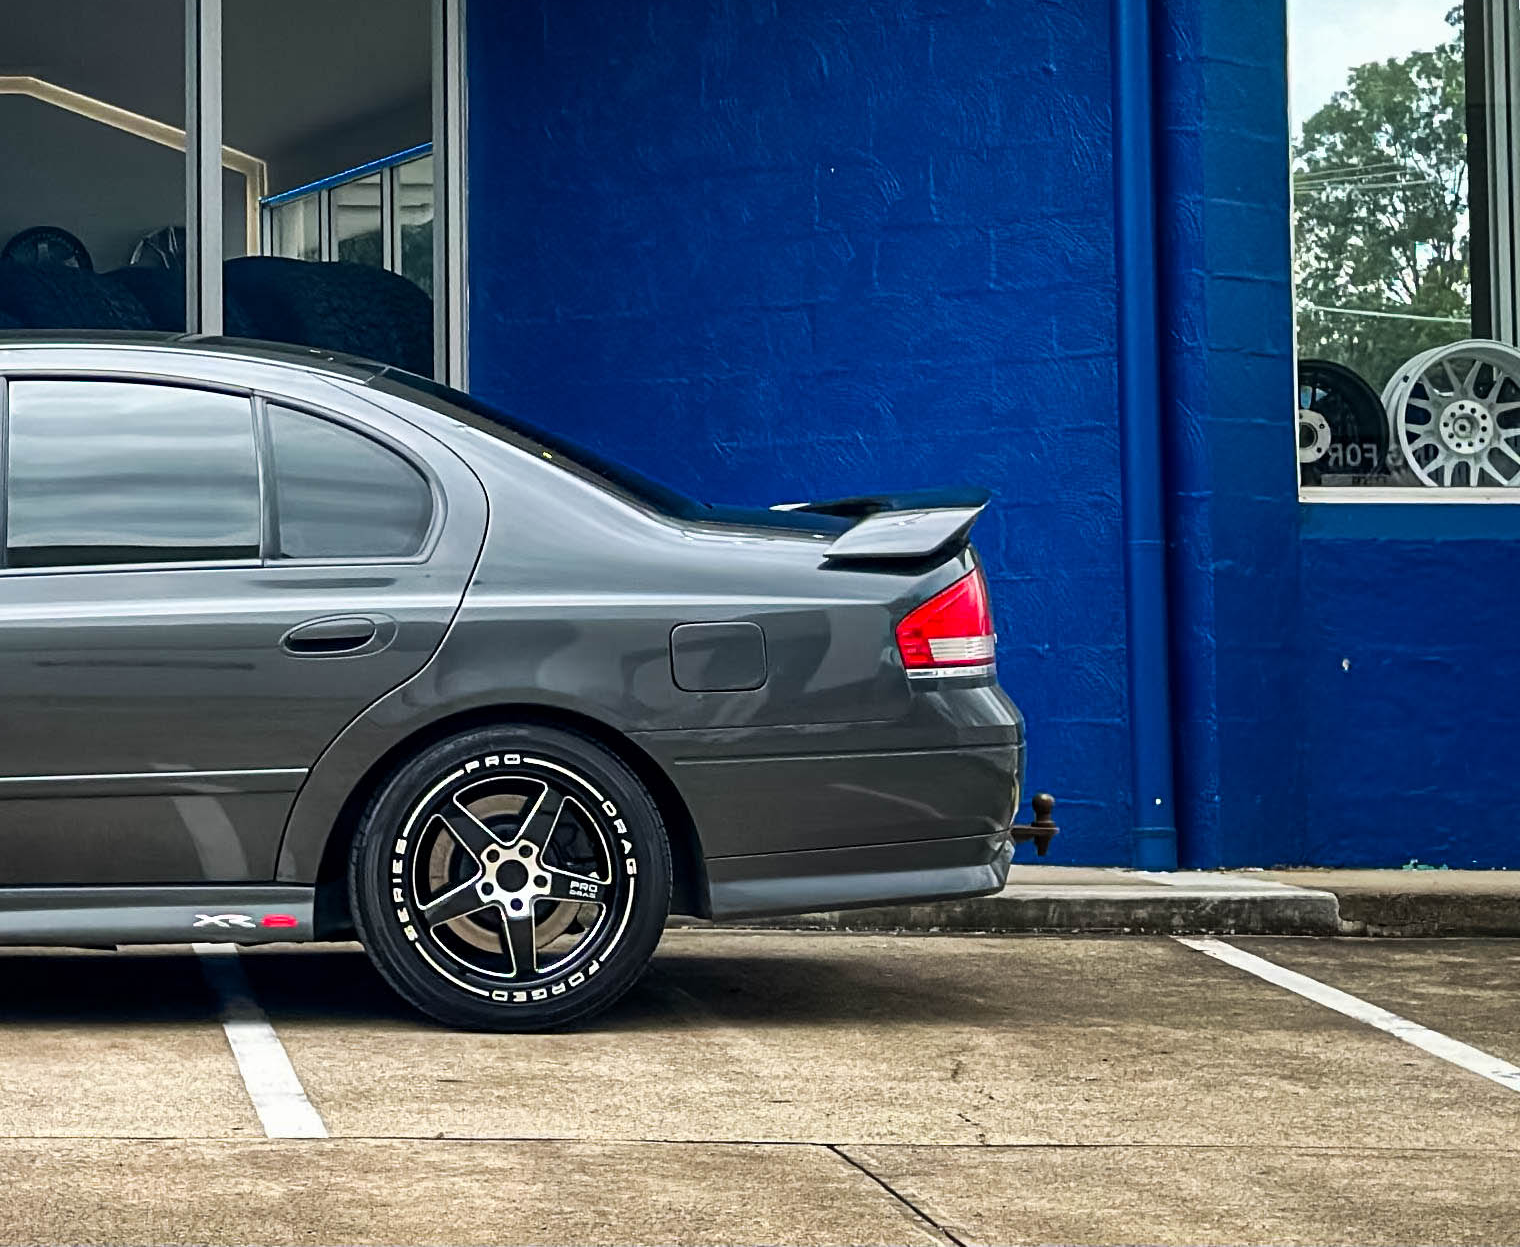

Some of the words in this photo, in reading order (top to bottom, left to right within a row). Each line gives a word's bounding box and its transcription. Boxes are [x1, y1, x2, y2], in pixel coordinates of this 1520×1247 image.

[464, 753, 521, 774] PRO
[601, 800, 637, 875] DRAG
[392, 838, 419, 942] SERIES
[570, 880, 598, 893] PRO
[491, 959, 601, 1002] FORGED
